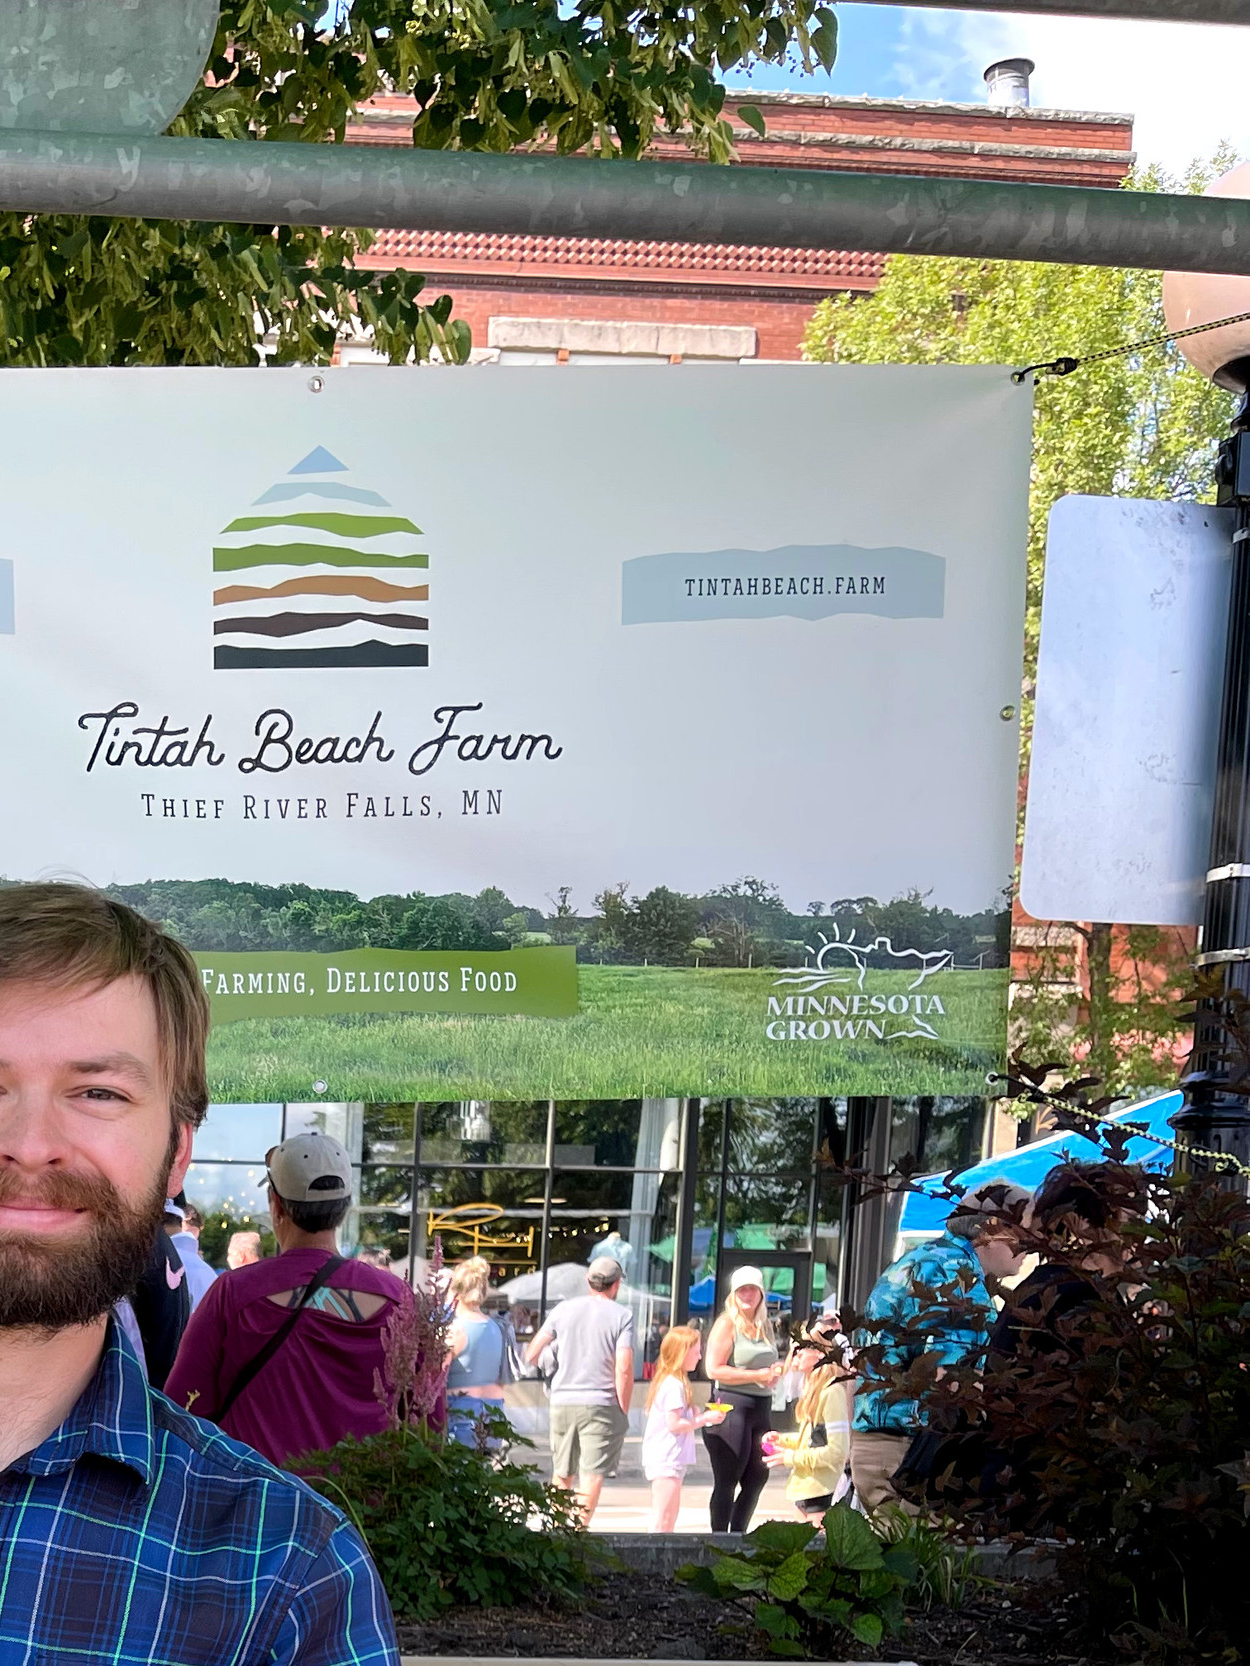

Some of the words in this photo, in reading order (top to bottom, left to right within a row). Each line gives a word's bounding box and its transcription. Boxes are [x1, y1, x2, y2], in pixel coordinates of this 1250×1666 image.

[685, 576, 886, 596] TINTAHBEACH.FARM
[78, 702, 225, 773] Tintah
[238, 709, 395, 774] Beach
[408, 702, 563, 776] Farm
[461, 789, 503, 816] MN
[766, 994, 946, 1016] MINNESOTA
[766, 1019, 886, 1041] GROWN
